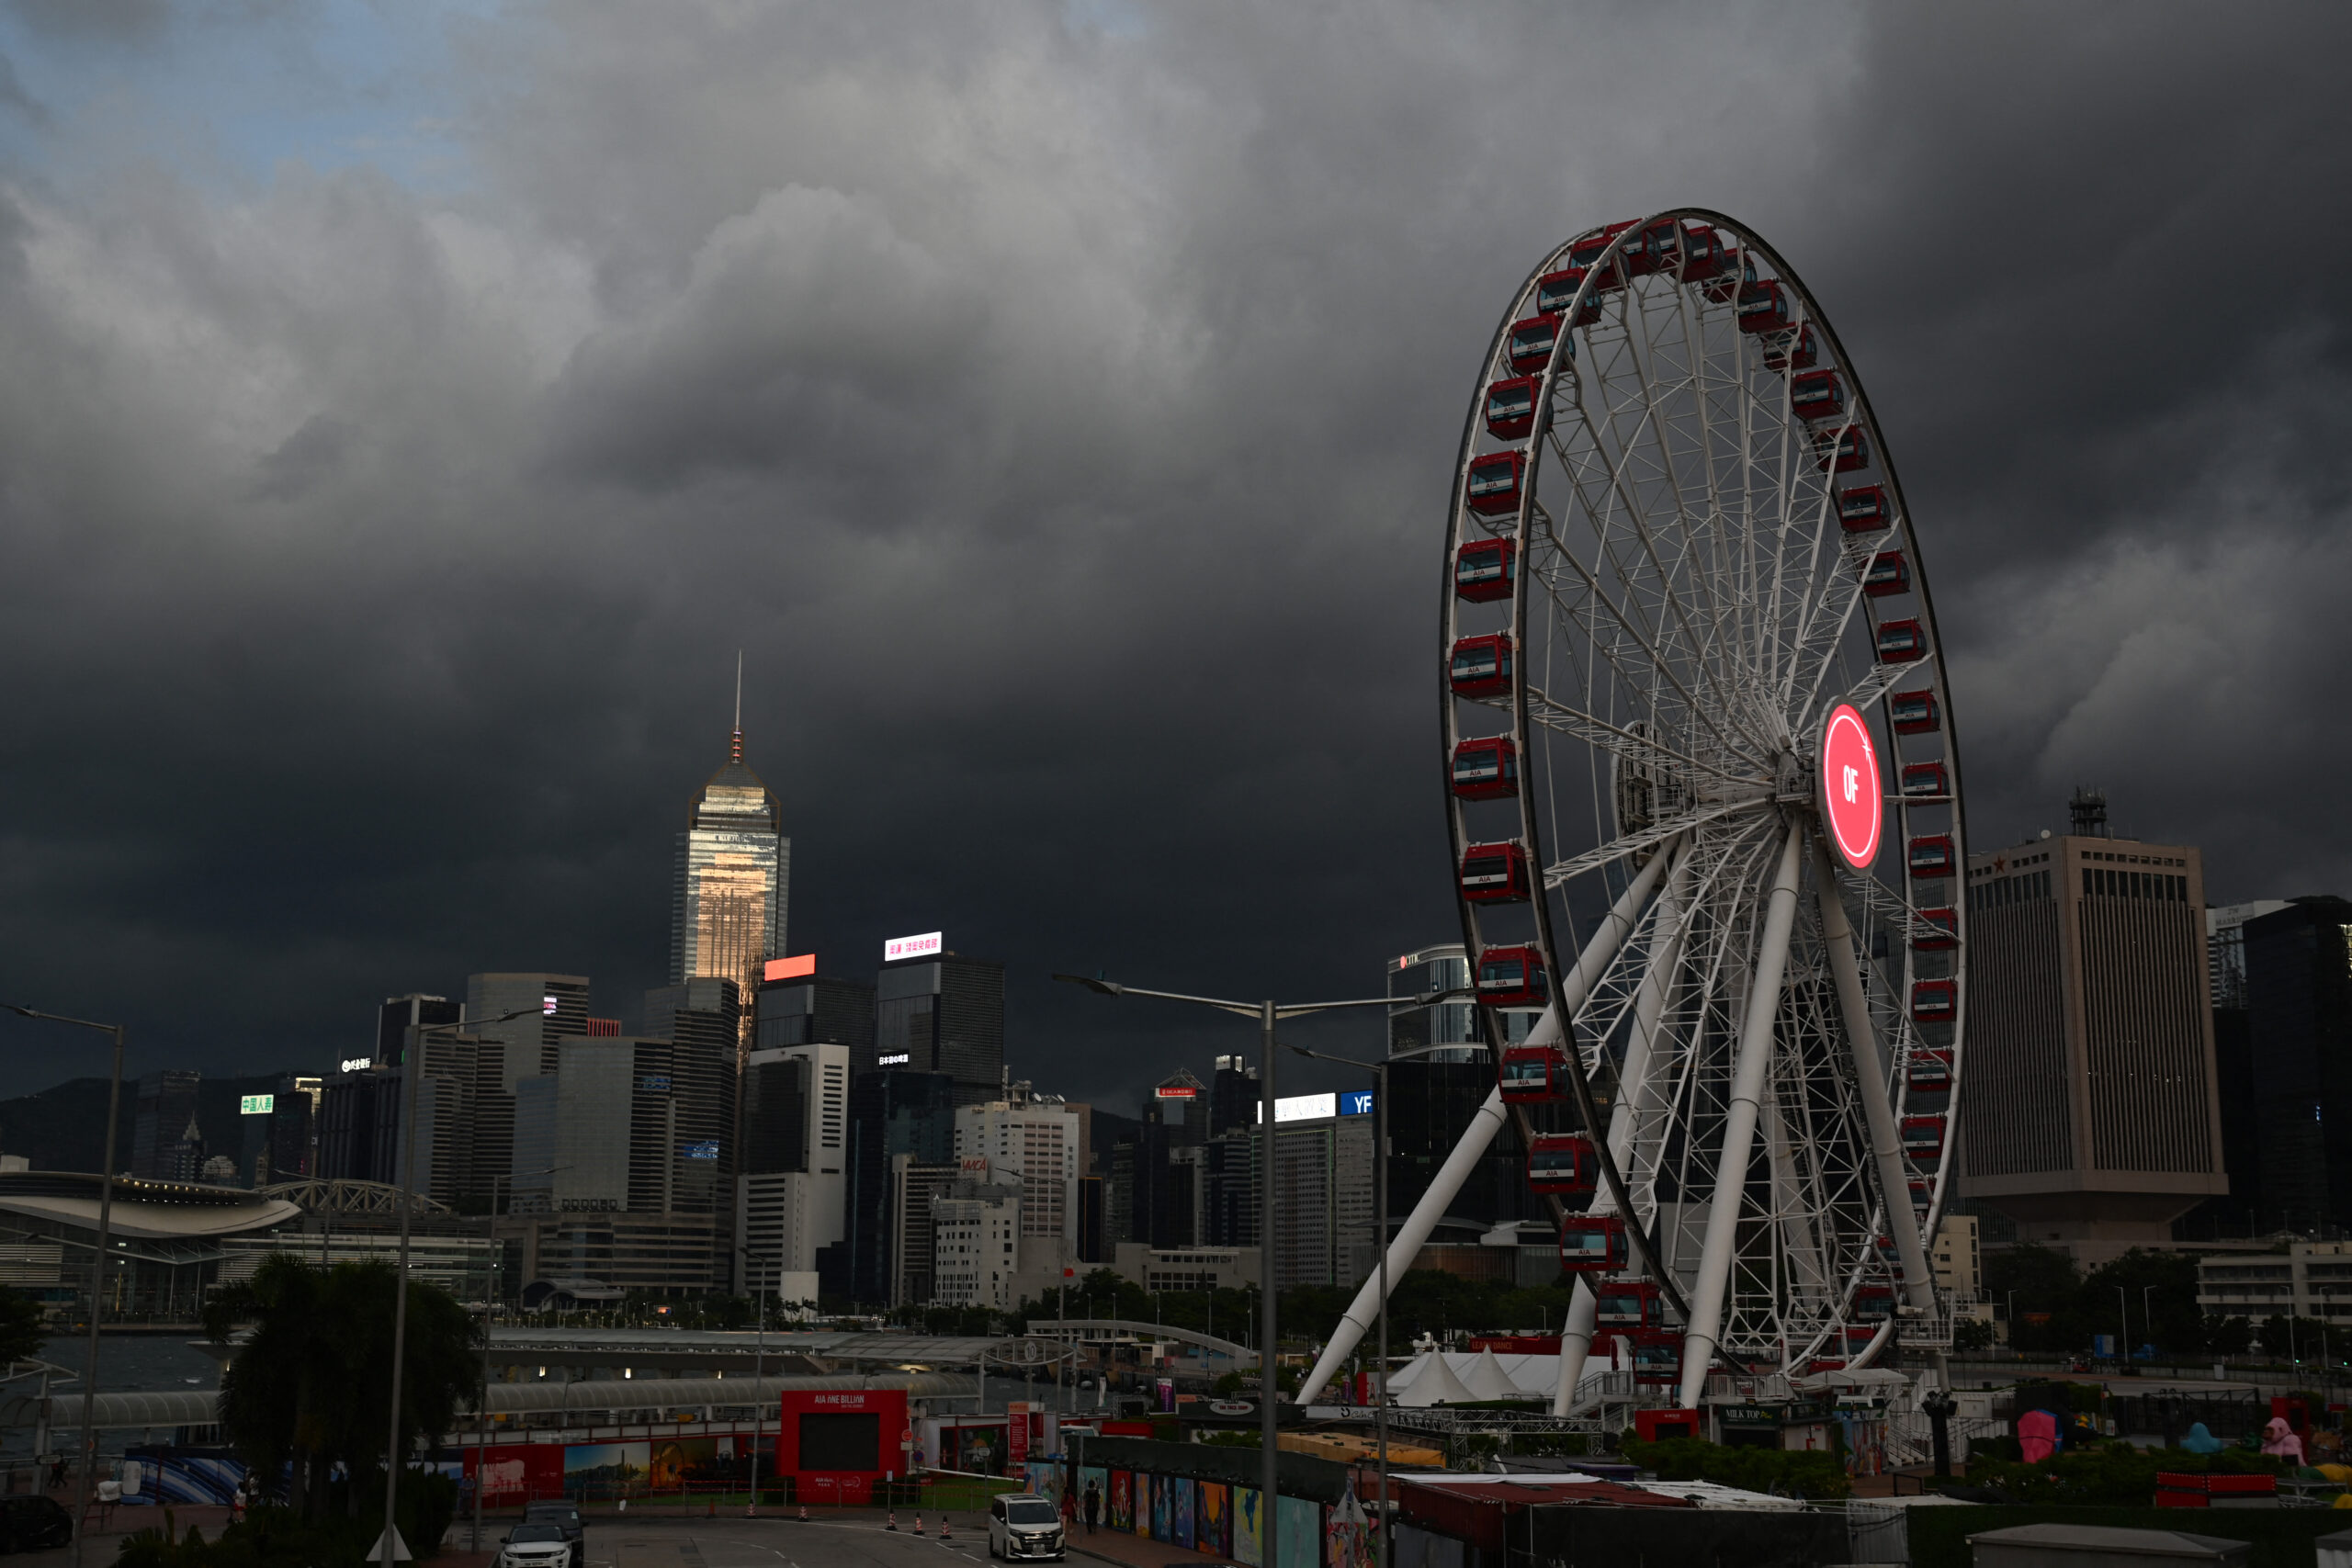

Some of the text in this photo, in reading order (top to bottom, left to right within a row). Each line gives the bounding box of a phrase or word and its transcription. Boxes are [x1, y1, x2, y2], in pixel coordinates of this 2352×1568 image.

[1843, 765, 1858, 804] OF
[1354, 1095, 1371, 1114] YF
[1493, 1342, 1513, 1350] DANCE
[814, 1395, 826, 1404] AIA
[1726, 1409, 1744, 1418] MILK
[1746, 1410, 1760, 1419] TOP
